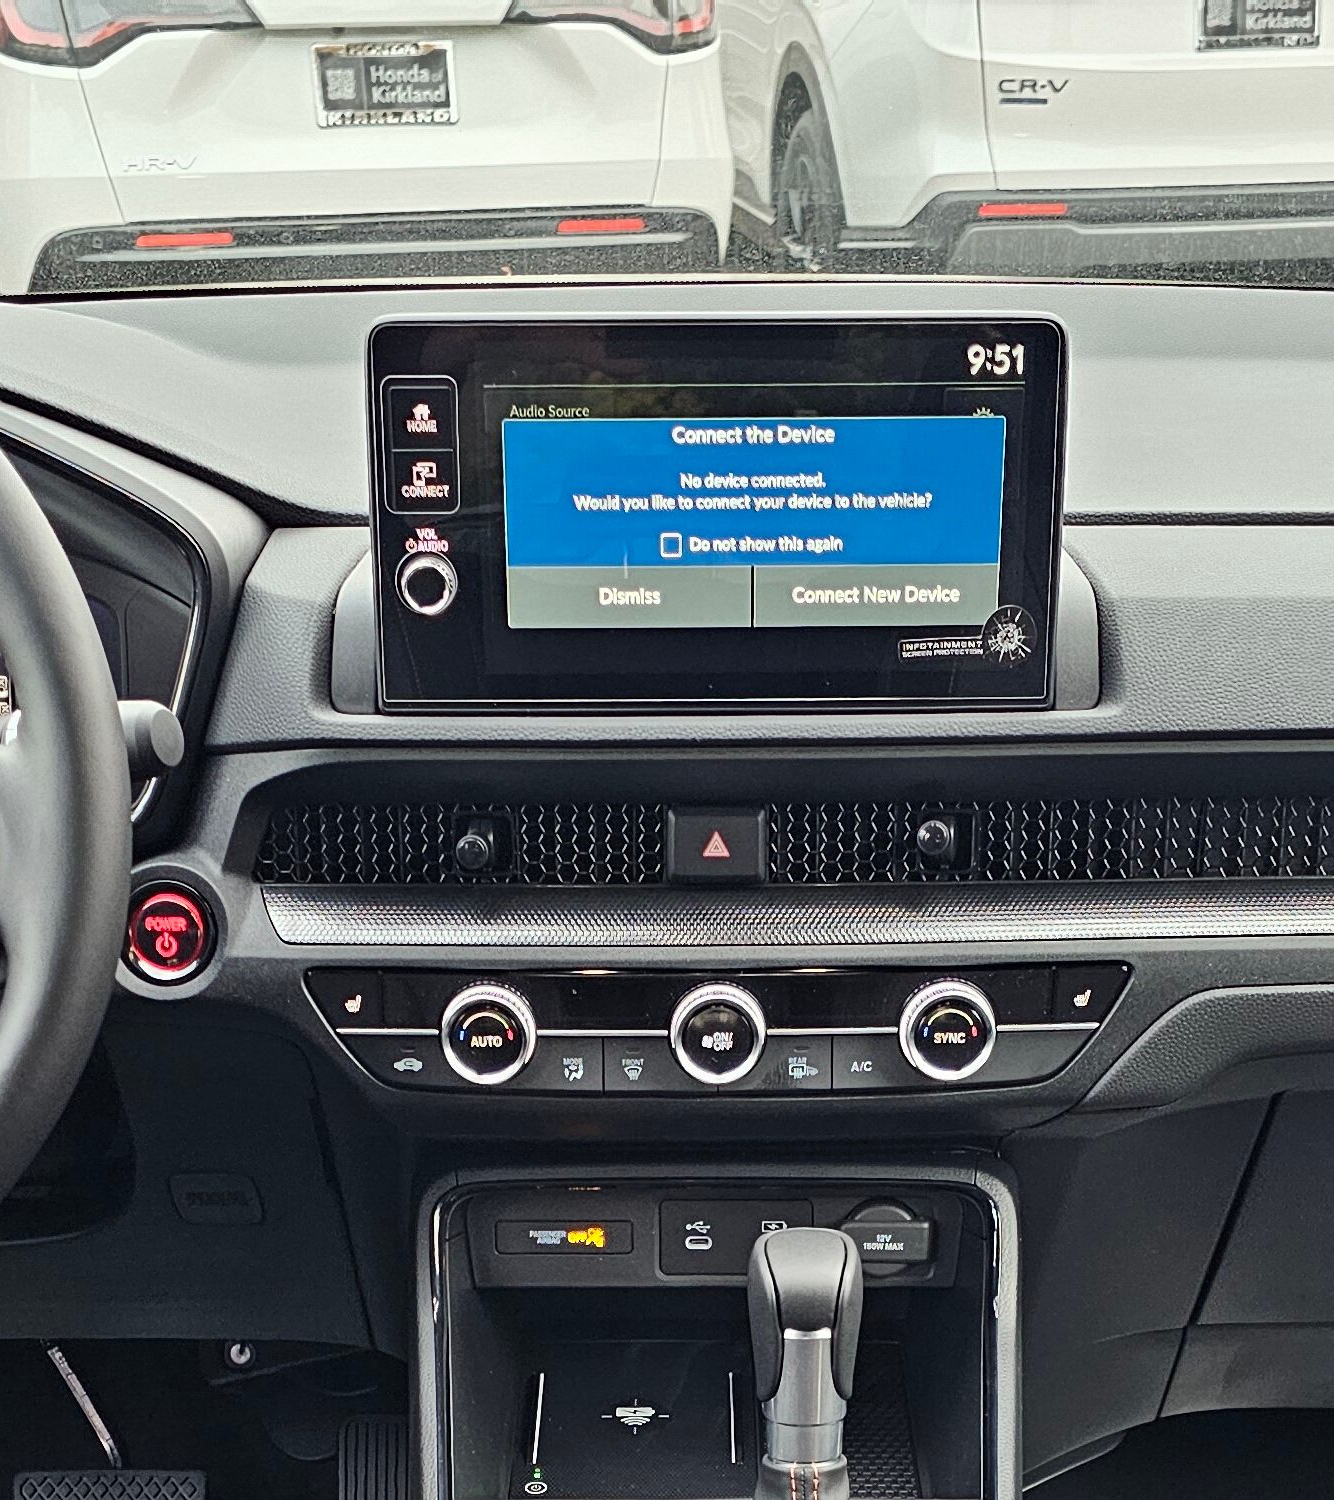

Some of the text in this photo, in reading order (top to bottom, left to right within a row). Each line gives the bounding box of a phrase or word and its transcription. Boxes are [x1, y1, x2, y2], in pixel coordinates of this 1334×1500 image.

[370, 63, 430, 83] Honda
[998, 79, 1069, 93] CR-V
[372, 84, 446, 103] Kirkland
[967, 343, 1025, 376] 9:51
[509, 404, 590, 418] Audio Source
[406, 420, 438, 433] HOME
[671, 425, 836, 445] Connect the Device
[680, 472, 826, 489] No device connected.
[401, 485, 450, 498] CONNECT
[572, 492, 933, 513] Would you like to connect your device to the vehicle?
[415, 528, 438, 541] VOL
[417, 540, 449, 552] AUDIO
[689, 535, 844, 553] Do not show this again
[599, 587, 661, 606] Dismiss
[792, 585, 961, 604] Connect New Device
[902, 640, 983, 652] INFOTAINMENT
[902, 648, 984, 658] SCREEN PROTECTION
[145, 916, 187, 931] POWER
[470, 1036, 503, 1048] AUTO
[933, 1032, 966, 1044] SYNC
[850, 1061, 873, 1072] A/C
